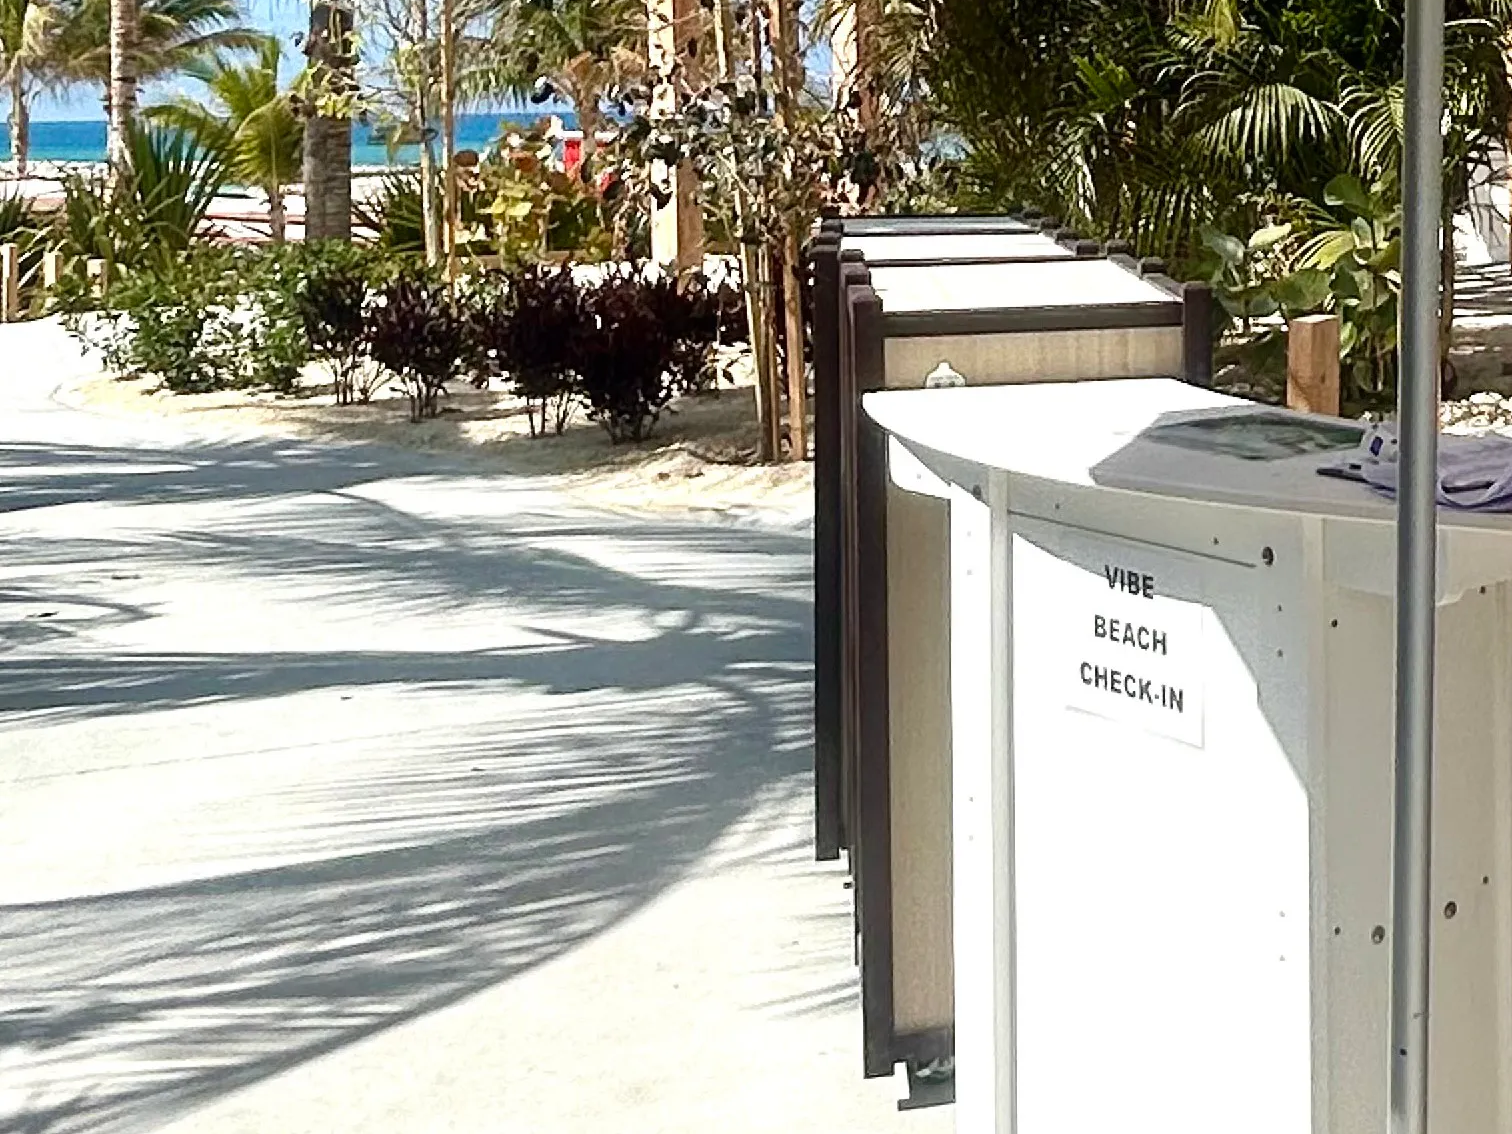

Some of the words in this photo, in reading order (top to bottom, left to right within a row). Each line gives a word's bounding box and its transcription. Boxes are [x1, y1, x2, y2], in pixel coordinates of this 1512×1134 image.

[1104, 564, 1154, 599] VIBE
[1094, 614, 1167, 655] BEACH
[1080, 661, 1183, 713] CHECK-IN
